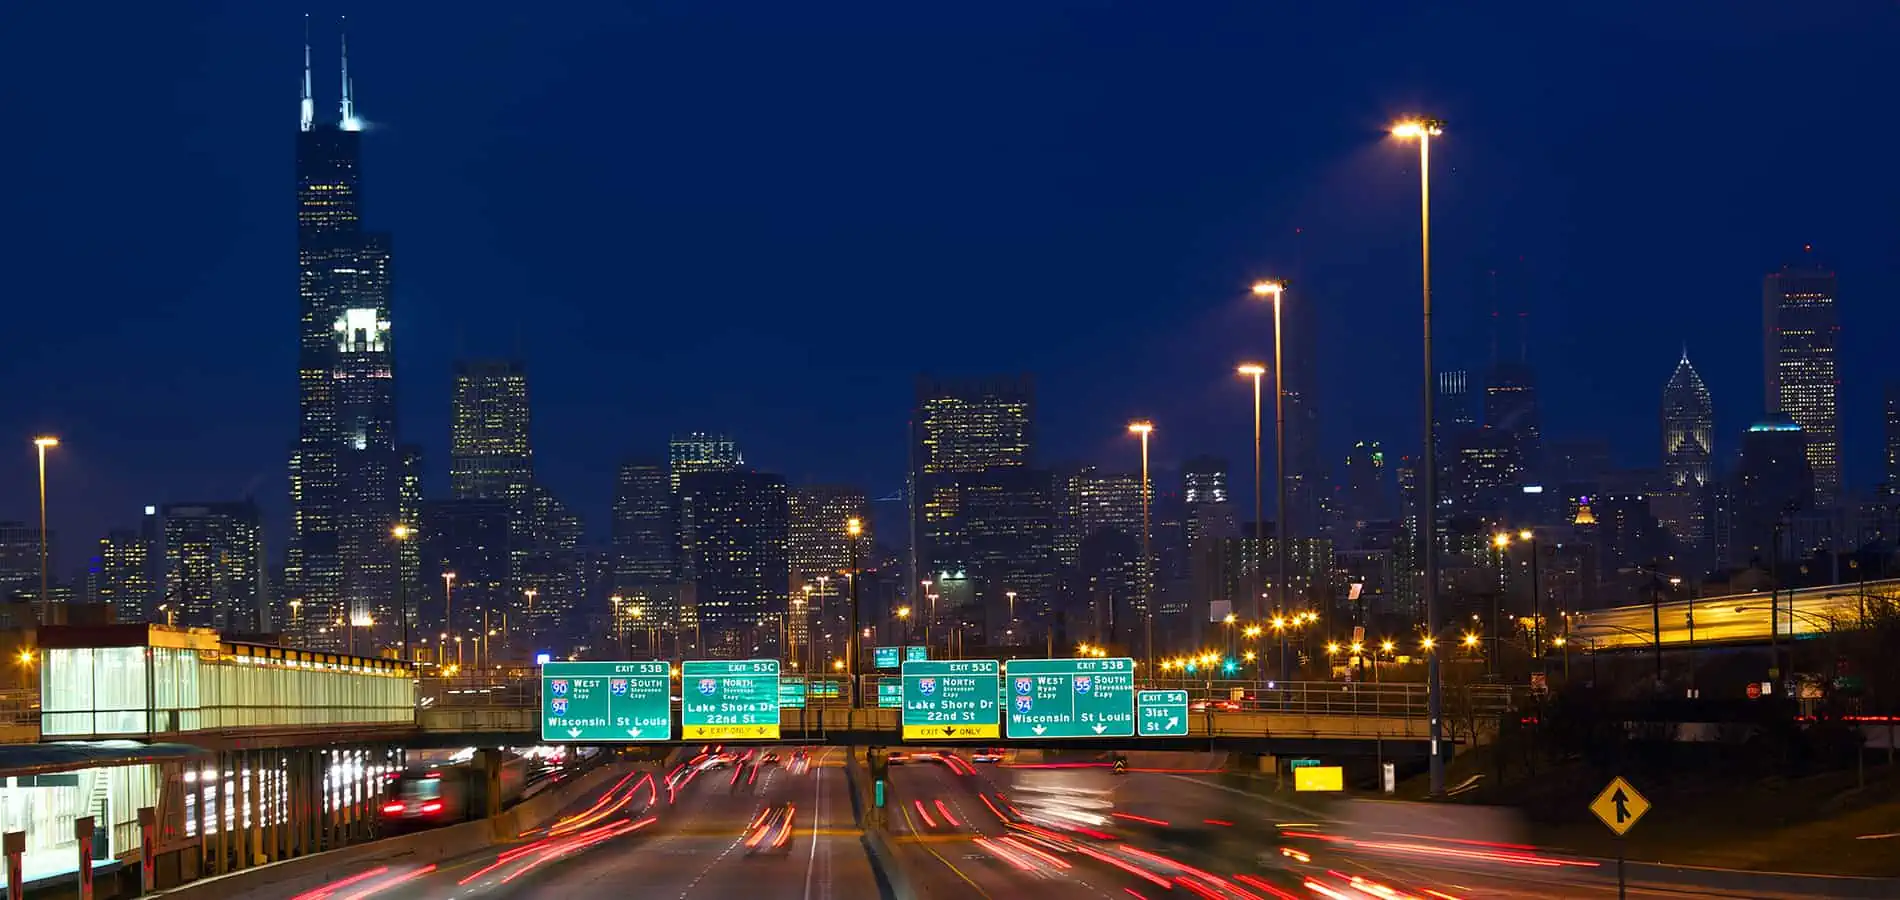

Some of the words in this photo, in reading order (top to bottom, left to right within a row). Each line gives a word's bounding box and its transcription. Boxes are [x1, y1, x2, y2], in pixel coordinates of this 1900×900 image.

[615, 665, 634, 673] EXIT
[640, 664, 662, 673] 53B
[728, 664, 746, 672] EXIT
[754, 663, 775, 672] 53C
[972, 663, 993, 672] 53C
[1101, 661, 1124, 670] 53B
[573, 679, 600, 688] WEST
[630, 679, 662, 688] SOUTH
[722, 679, 753, 687] NORTH
[942, 677, 975, 686] NORTH
[1037, 677, 1064, 685] WEST
[1094, 675, 1126, 684] SOUTH
[553, 684, 567, 693] 90
[612, 684, 626, 693] 55
[701, 684, 716, 693] 55
[921, 682, 935, 692] 55
[1017, 681, 1031, 690] 90
[1076, 681, 1090, 690] 55
[1143, 694, 1162, 702] EXIT
[1168, 693, 1182, 702] 54
[552, 702, 566, 712] 94
[687, 703, 716, 712] Lake
[721, 703, 755, 712] Shore
[760, 702, 774, 711] Dr
[907, 700, 936, 710] Lake
[941, 700, 975, 709] Shore
[980, 699, 993, 709] Dr
[1016, 700, 1031, 709] 94
[927, 711, 957, 720] 22nd
[962, 711, 975, 720] St
[1145, 708, 1169, 717] 31st
[548, 717, 606, 726] Wisconsin
[617, 717, 630, 726] St
[635, 717, 667, 726] Louis
[706, 714, 737, 724] 22nd
[743, 714, 756, 723] St
[1012, 714, 1070, 723] Wisconsin
[1081, 713, 1094, 722] St
[1100, 713, 1131, 722] Louis
[1147, 721, 1160, 730] St
